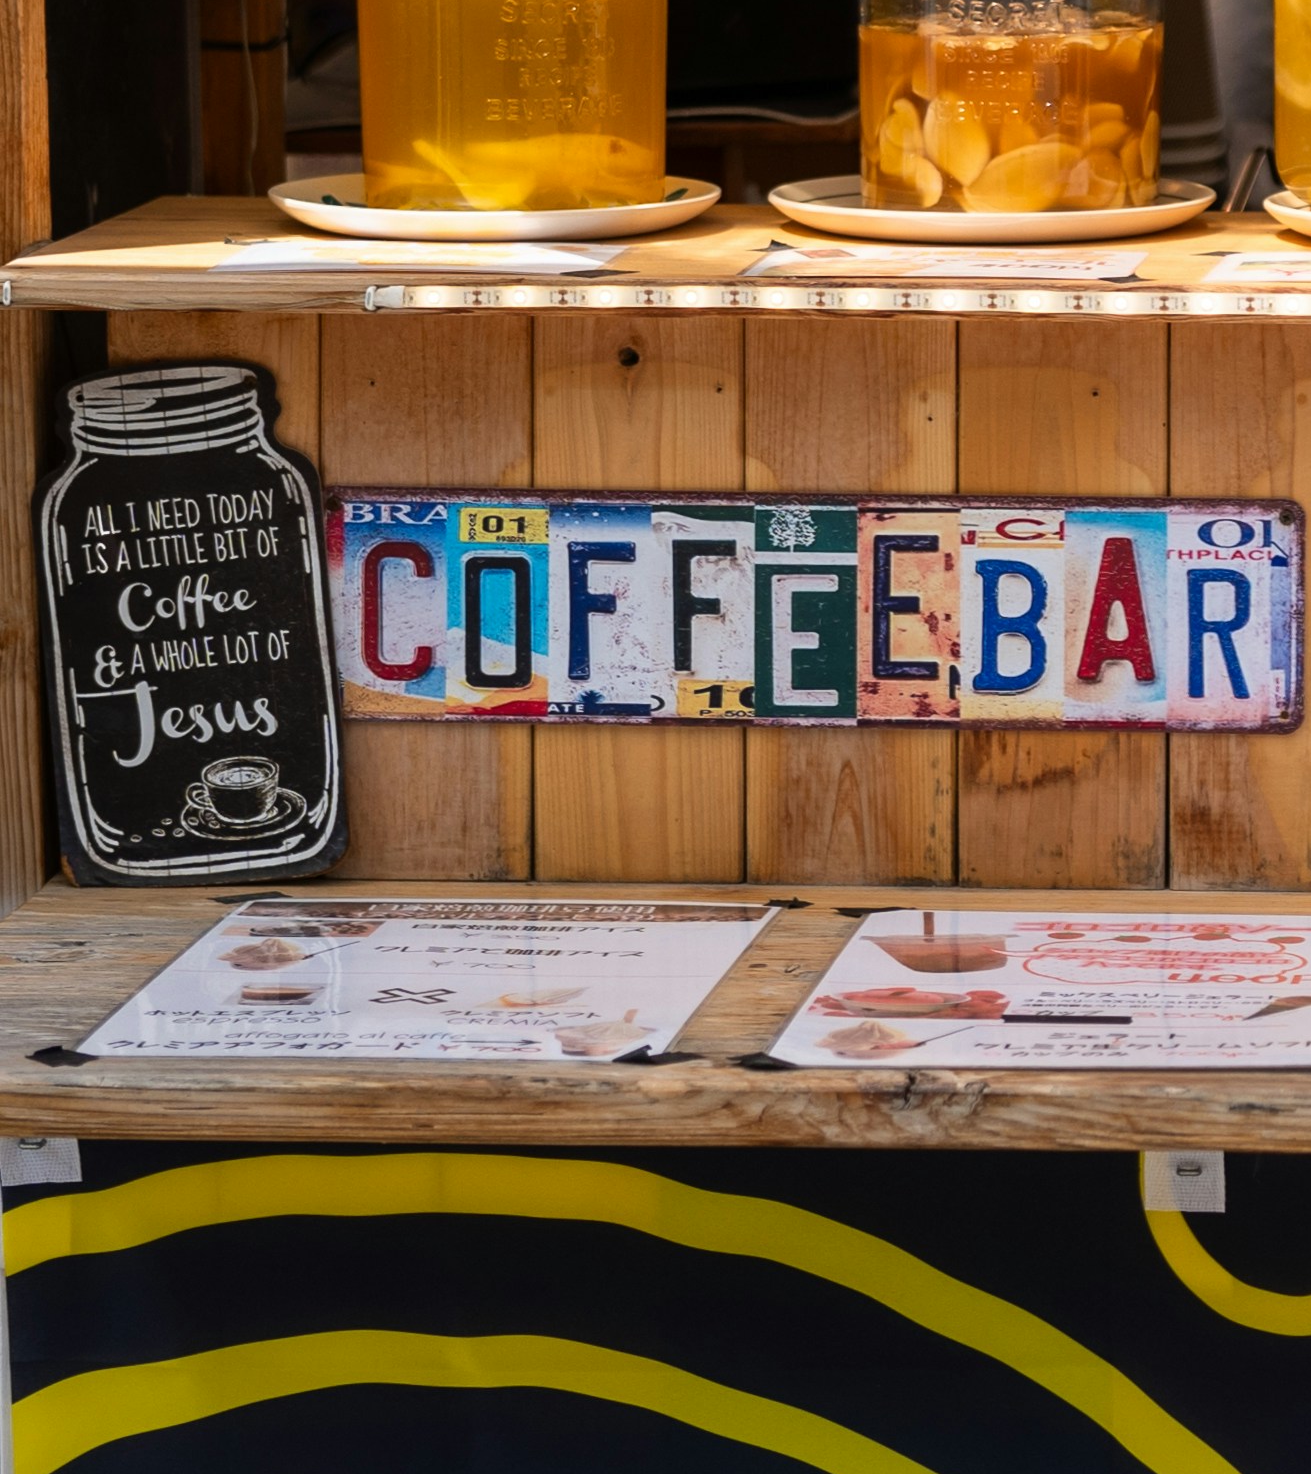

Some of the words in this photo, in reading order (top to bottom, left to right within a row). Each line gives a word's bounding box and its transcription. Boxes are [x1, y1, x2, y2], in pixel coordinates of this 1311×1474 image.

[84, 503, 120, 537] ALL
[147, 498, 199, 529] NEED
[207, 489, 275, 524] TODAY
[82, 544, 108, 574] IS
[116, 541, 131, 572] A
[137, 536, 203, 569] LITTLE
[214, 531, 247, 562] BIT
[257, 527, 279, 557] OF
[118, 574, 257, 631] Coffee
[131, 642, 144, 674] A
[154, 638, 214, 671] WHOLE
[223, 634, 259, 666] LOT
[268, 630, 290, 661] OF
[77, 680, 279, 767] Jesus
